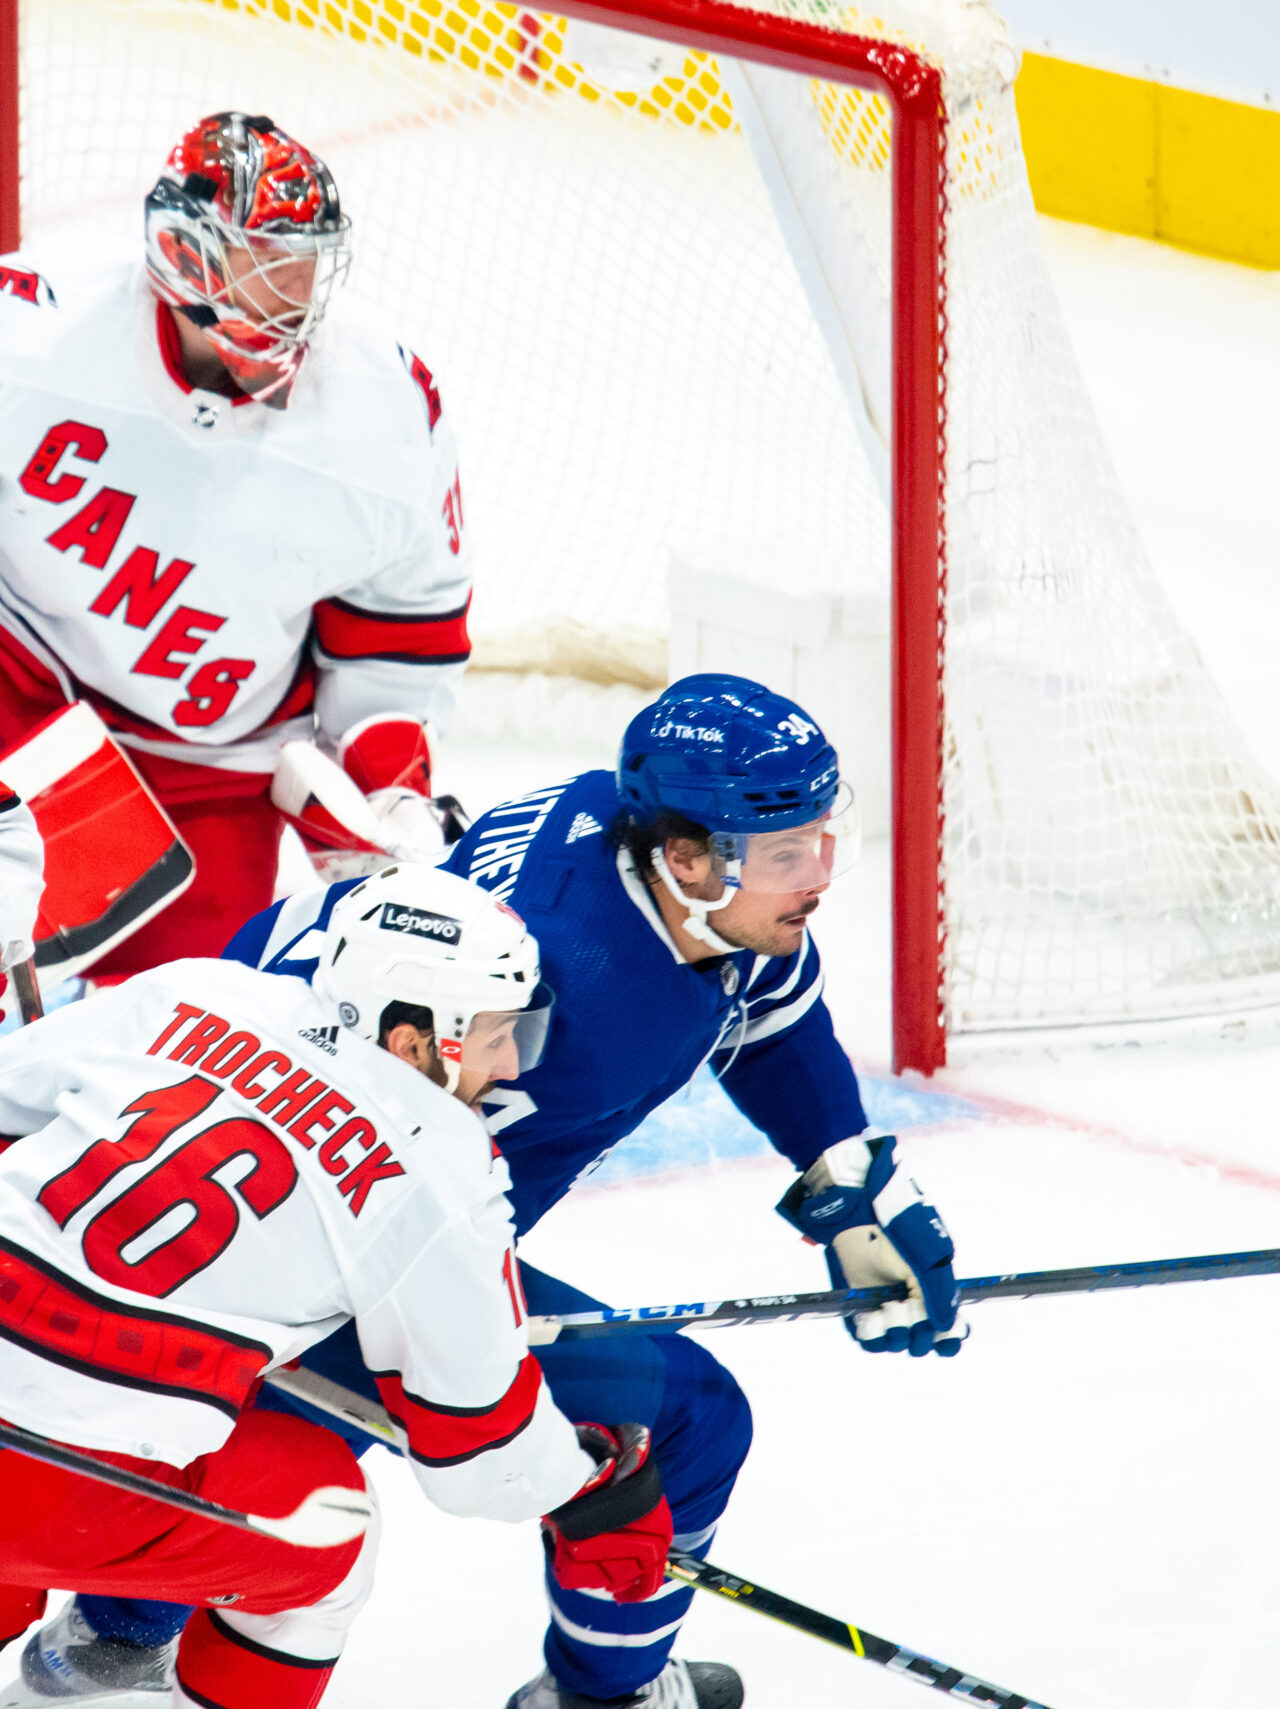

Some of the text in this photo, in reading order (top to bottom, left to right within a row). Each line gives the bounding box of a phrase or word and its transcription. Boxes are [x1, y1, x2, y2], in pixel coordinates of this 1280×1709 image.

[19, 419, 256, 730] CANES
[675, 724, 725, 743] TikTok
[777, 713, 819, 745] 34
[810, 766, 837, 792] CC
[385, 908, 457, 938] Lenovo
[298, 1029, 338, 1056] adidas
[145, 1002, 407, 1218] TROCHECK
[37, 1073, 299, 1300] 16
[502, 1247, 528, 1329] 1
[602, 1302, 705, 1323] CCM
